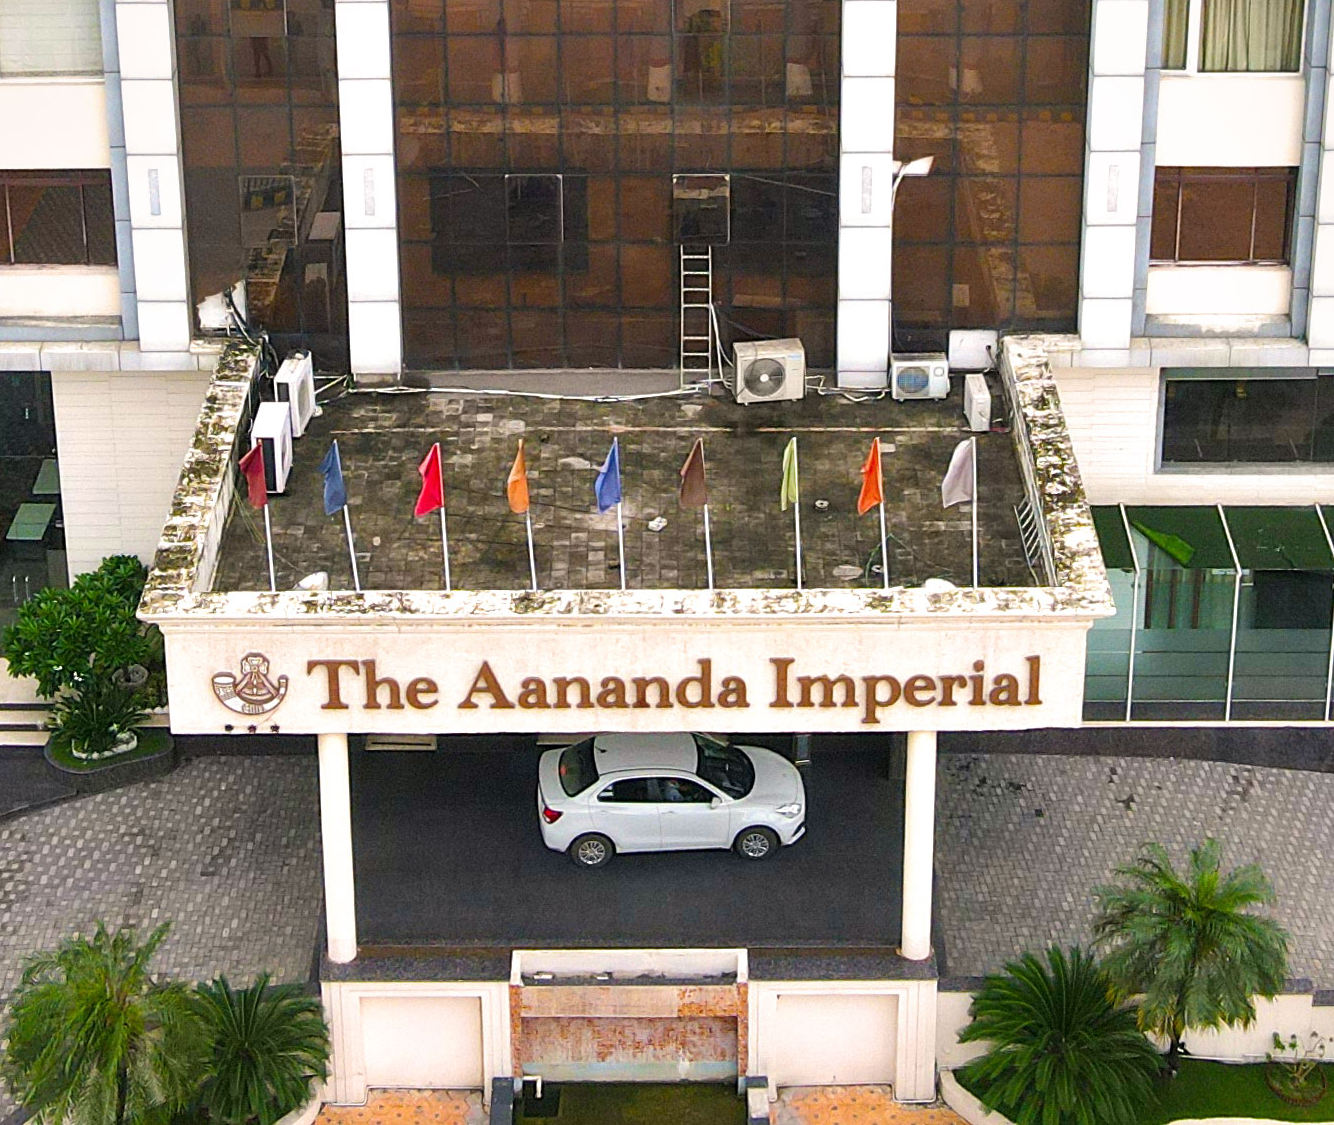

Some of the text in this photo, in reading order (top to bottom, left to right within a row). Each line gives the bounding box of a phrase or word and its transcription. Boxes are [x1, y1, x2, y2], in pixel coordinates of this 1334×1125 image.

[306, 655, 1043, 725] The Aananda Imperial
